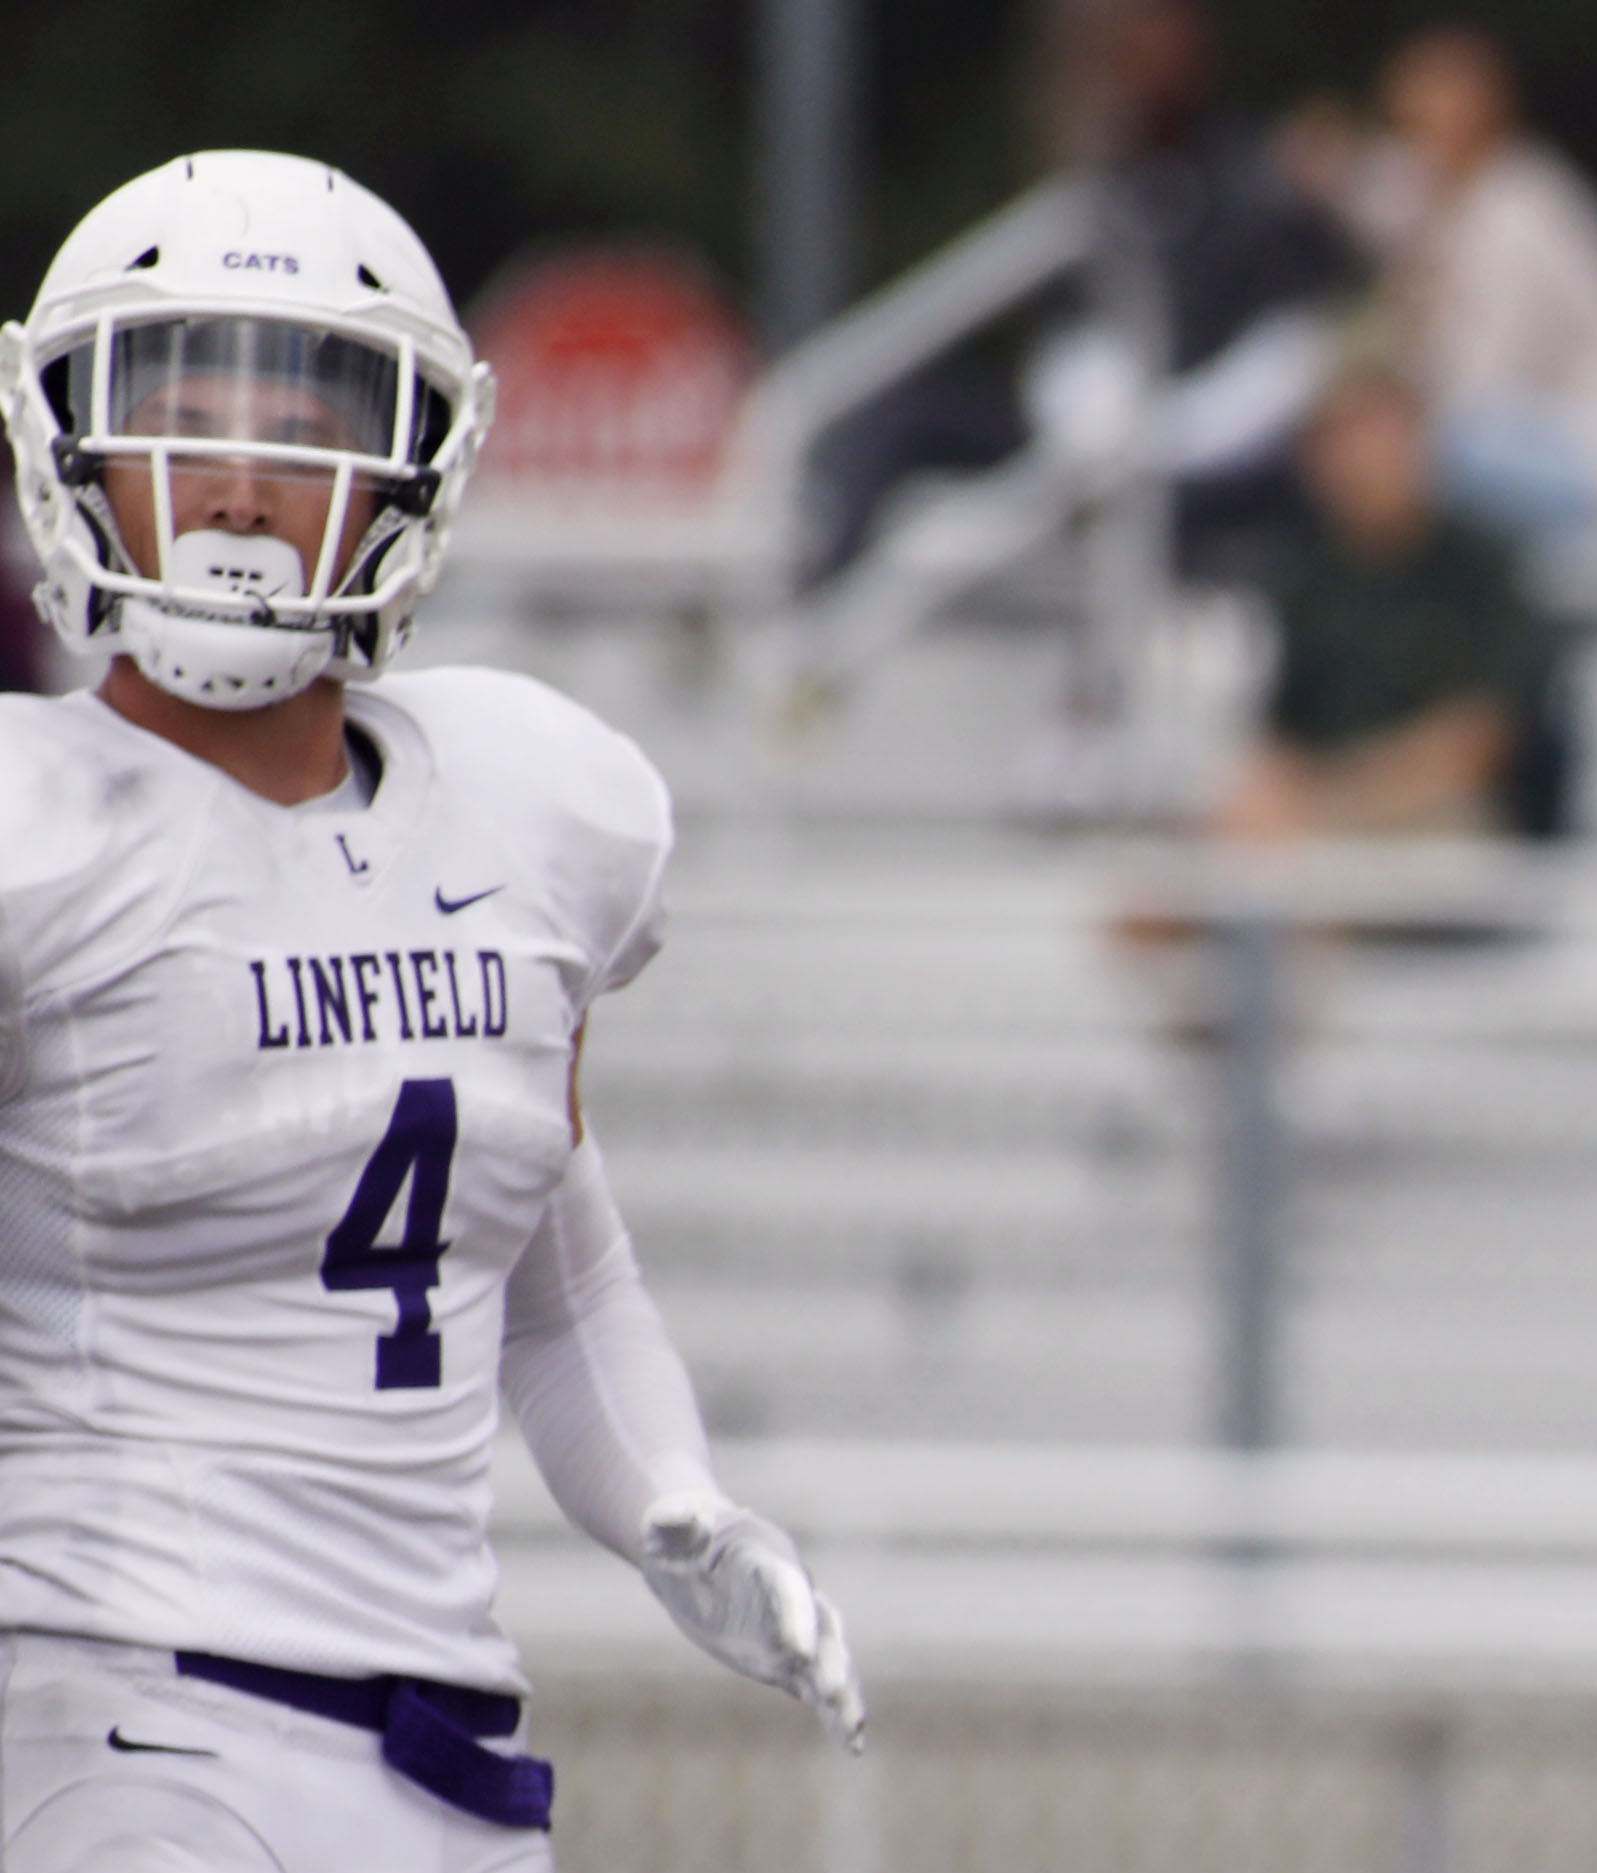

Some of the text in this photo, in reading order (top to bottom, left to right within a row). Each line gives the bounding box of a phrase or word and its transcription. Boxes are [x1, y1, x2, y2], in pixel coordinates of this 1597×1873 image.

[222, 251, 300, 275] CATS
[249, 949, 509, 1051] LINFIELD
[319, 1077, 458, 1390] 4
